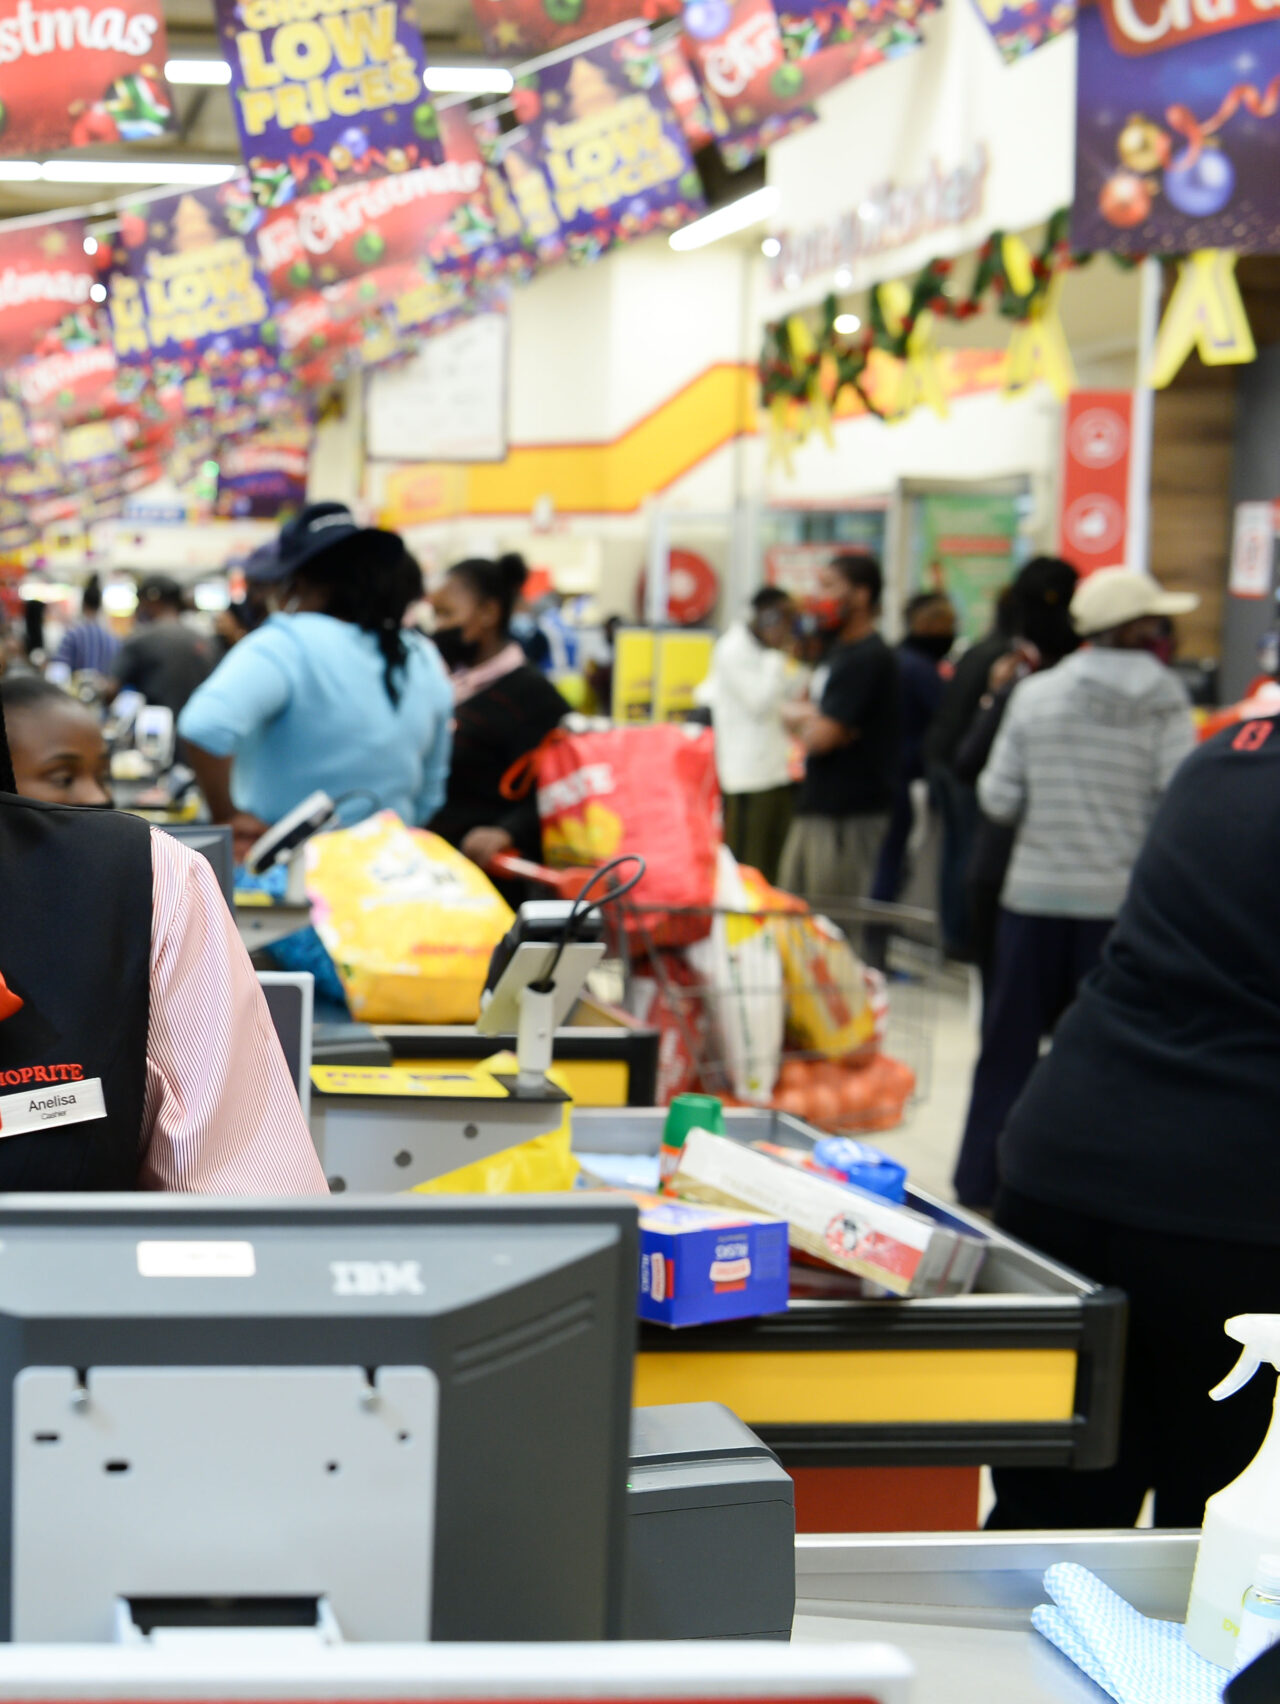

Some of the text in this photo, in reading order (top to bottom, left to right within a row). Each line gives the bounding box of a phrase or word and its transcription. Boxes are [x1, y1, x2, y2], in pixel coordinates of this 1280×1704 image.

[236, 4, 398, 89] LOW
[240, 56, 421, 137] PRICES
[28, 1094, 78, 1113] Anelisa
[330, 1260, 426, 1297] IBM
